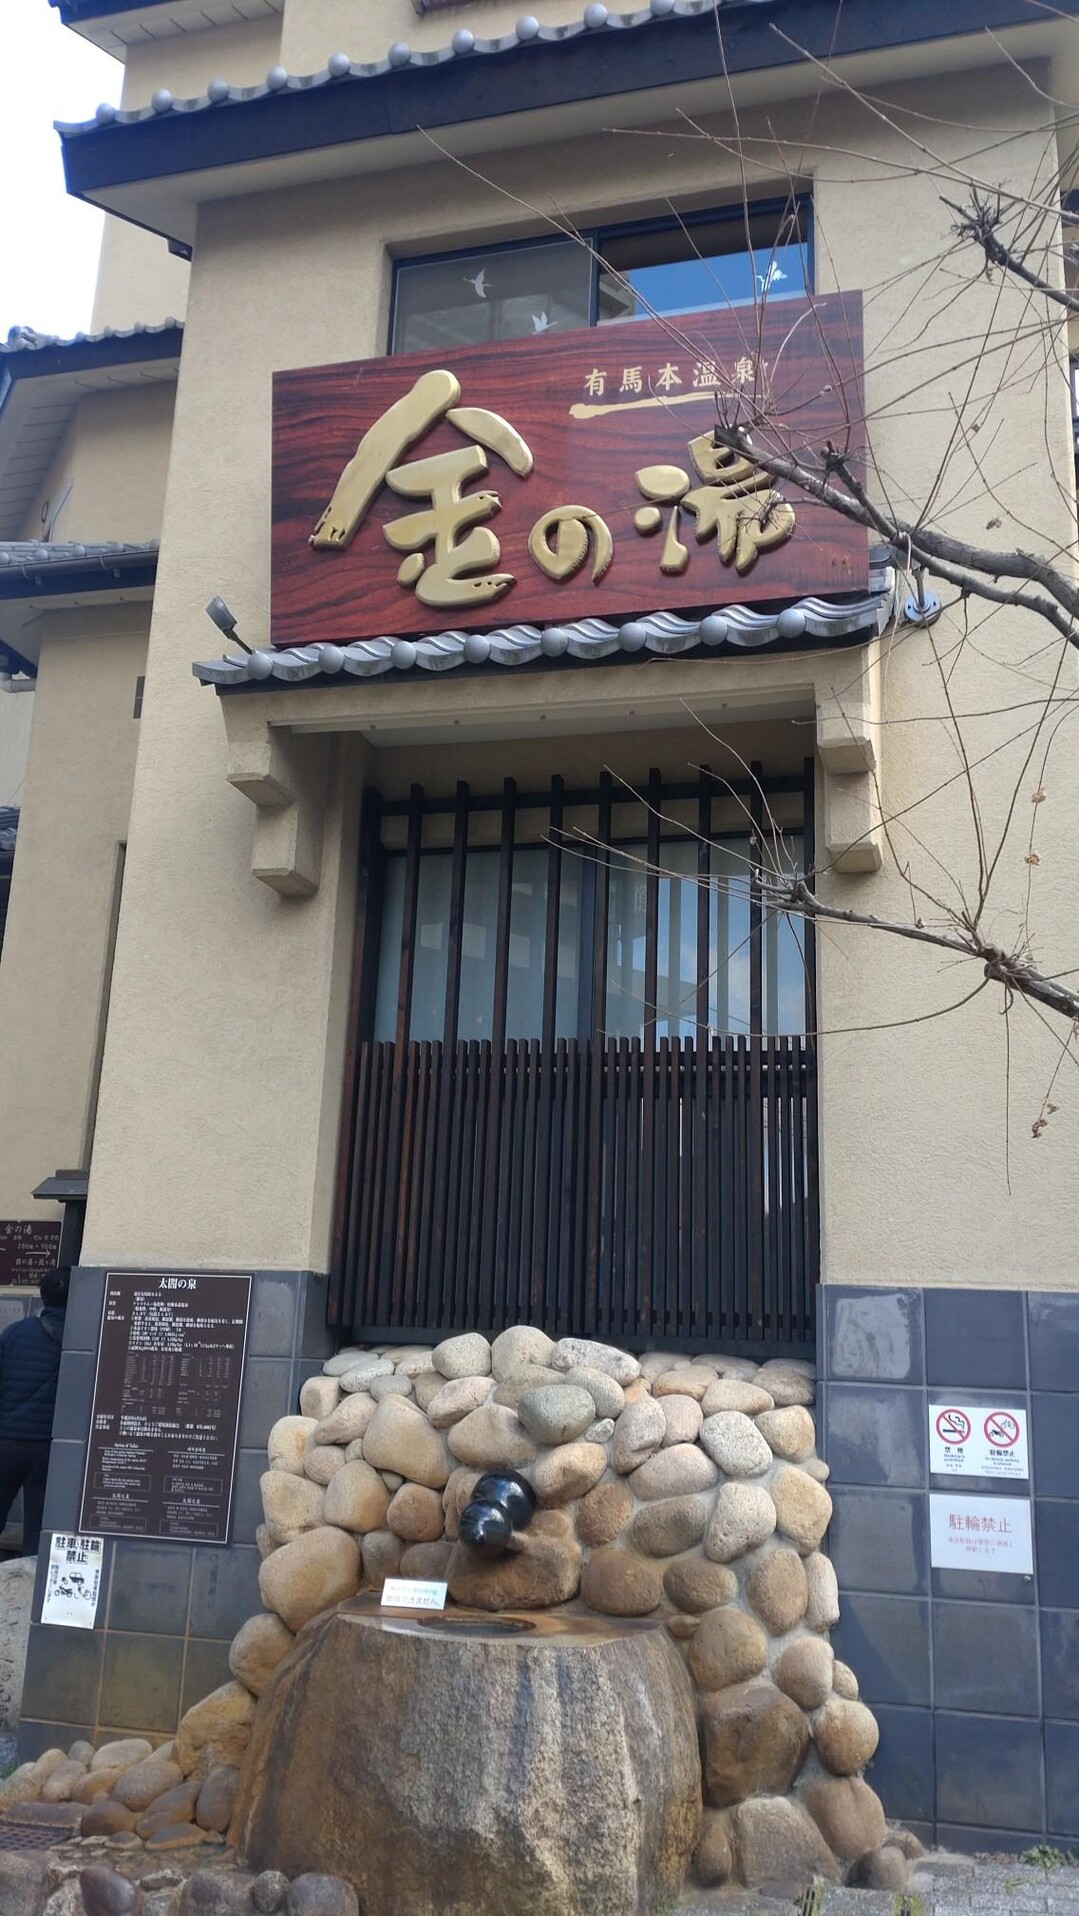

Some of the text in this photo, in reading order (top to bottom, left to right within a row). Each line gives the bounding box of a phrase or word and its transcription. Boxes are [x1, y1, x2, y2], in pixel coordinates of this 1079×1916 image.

[308, 369, 796, 607] 金の湯
[159, 1277, 197, 1289] 太閤の泉
[949, 1514, 1013, 1534] 駐輪禁止
[66, 1550, 87, 1562] 禁止
